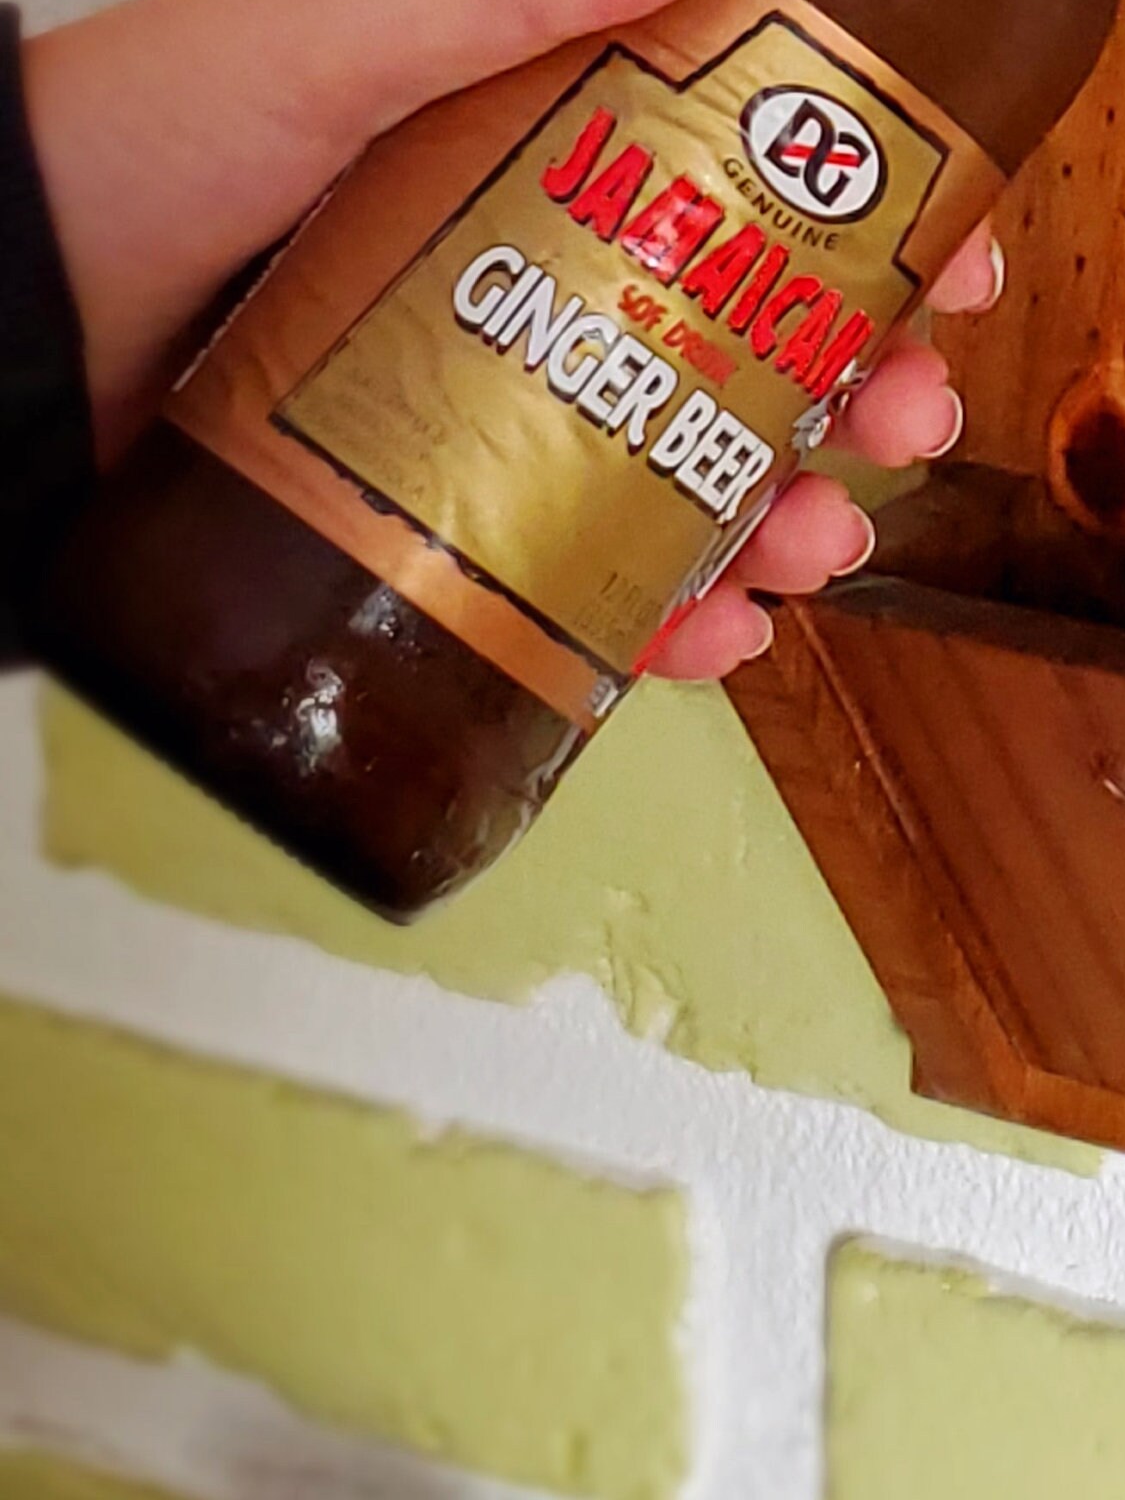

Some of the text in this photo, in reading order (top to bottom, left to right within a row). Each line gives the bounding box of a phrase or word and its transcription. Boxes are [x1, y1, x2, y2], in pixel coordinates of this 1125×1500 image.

[539, 105, 874, 400] JAMAICAN
[723, 158, 841, 251] GENUINE
[453, 243, 680, 452] GINGER
[648, 388, 776, 525] BEER
